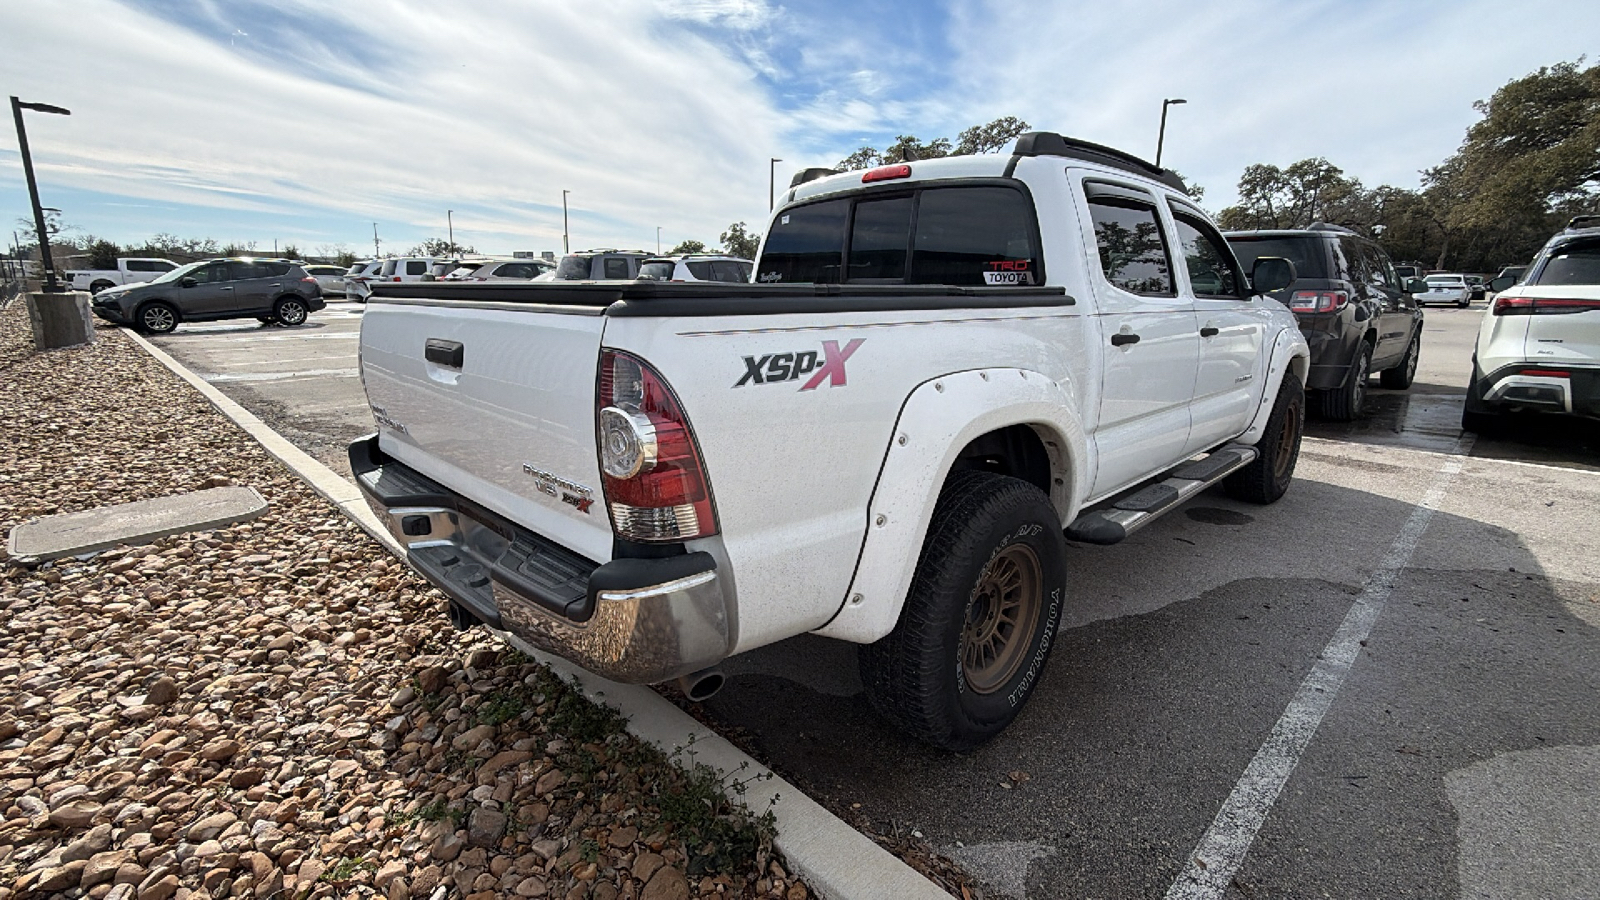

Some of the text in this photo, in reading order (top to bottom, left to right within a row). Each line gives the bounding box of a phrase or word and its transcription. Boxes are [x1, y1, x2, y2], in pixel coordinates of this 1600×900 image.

[989, 260, 1028, 271] TRD
[988, 272, 1028, 283] TOYOTA
[731, 338, 867, 392] XSP-X
[535, 480, 558, 498] V6
[1007, 588, 1061, 708] YOKOHAMA
